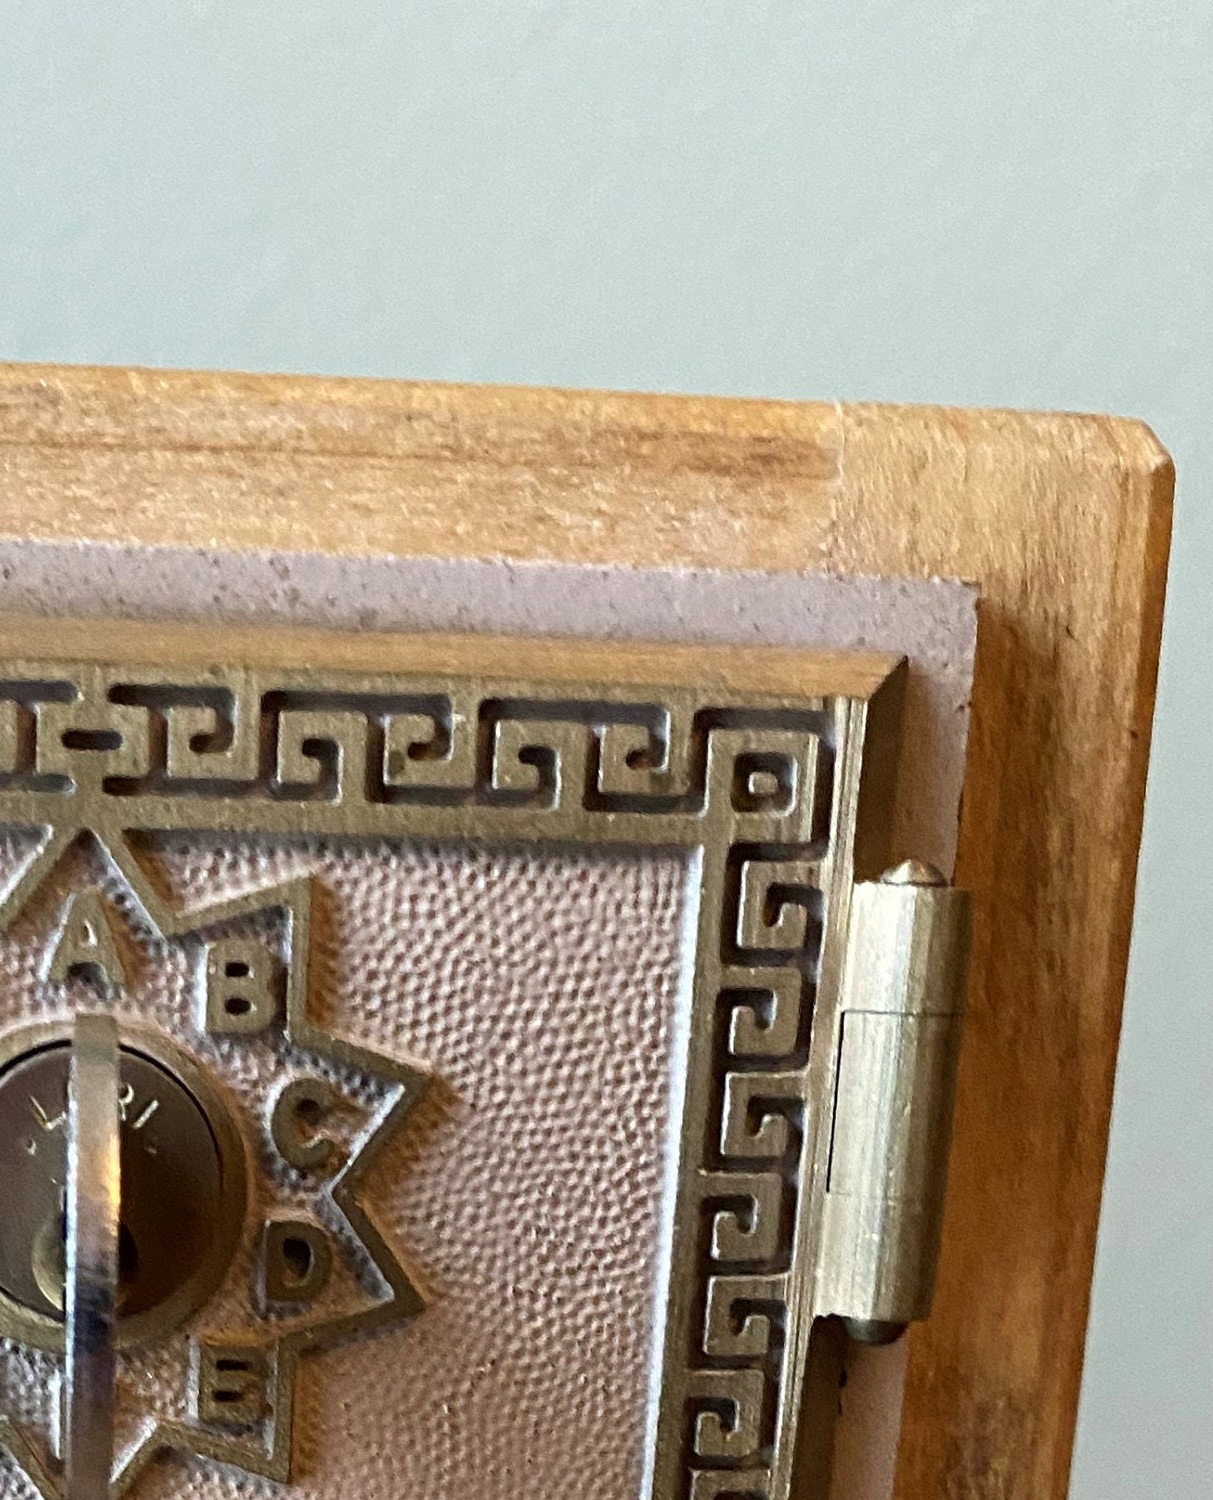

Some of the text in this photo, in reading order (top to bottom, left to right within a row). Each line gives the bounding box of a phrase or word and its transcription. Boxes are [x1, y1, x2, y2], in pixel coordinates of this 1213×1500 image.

[38, 893, 124, 986] A
[196, 938, 279, 1036] B
[28, 1082, 159, 1130] LRI
[268, 1075, 342, 1174] C
[259, 1219, 333, 1304] D
[190, 1342, 272, 1424] E
